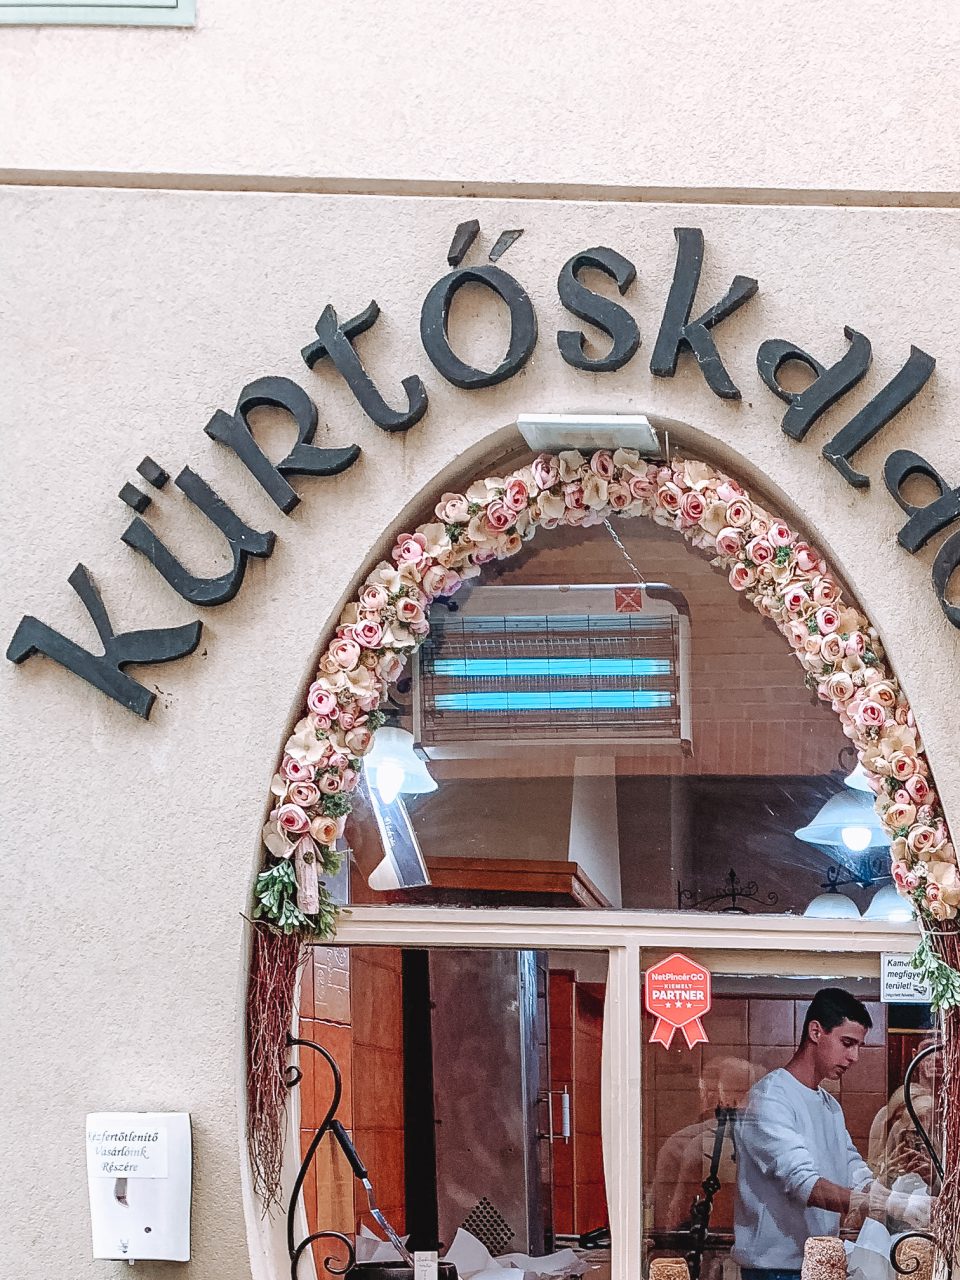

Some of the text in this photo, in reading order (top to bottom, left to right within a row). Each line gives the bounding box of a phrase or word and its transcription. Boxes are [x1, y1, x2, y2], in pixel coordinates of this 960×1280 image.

[887, 970, 924, 981] megfigyel
[885, 982, 912, 990] terület!
[652, 990, 705, 1001] PARTNER
